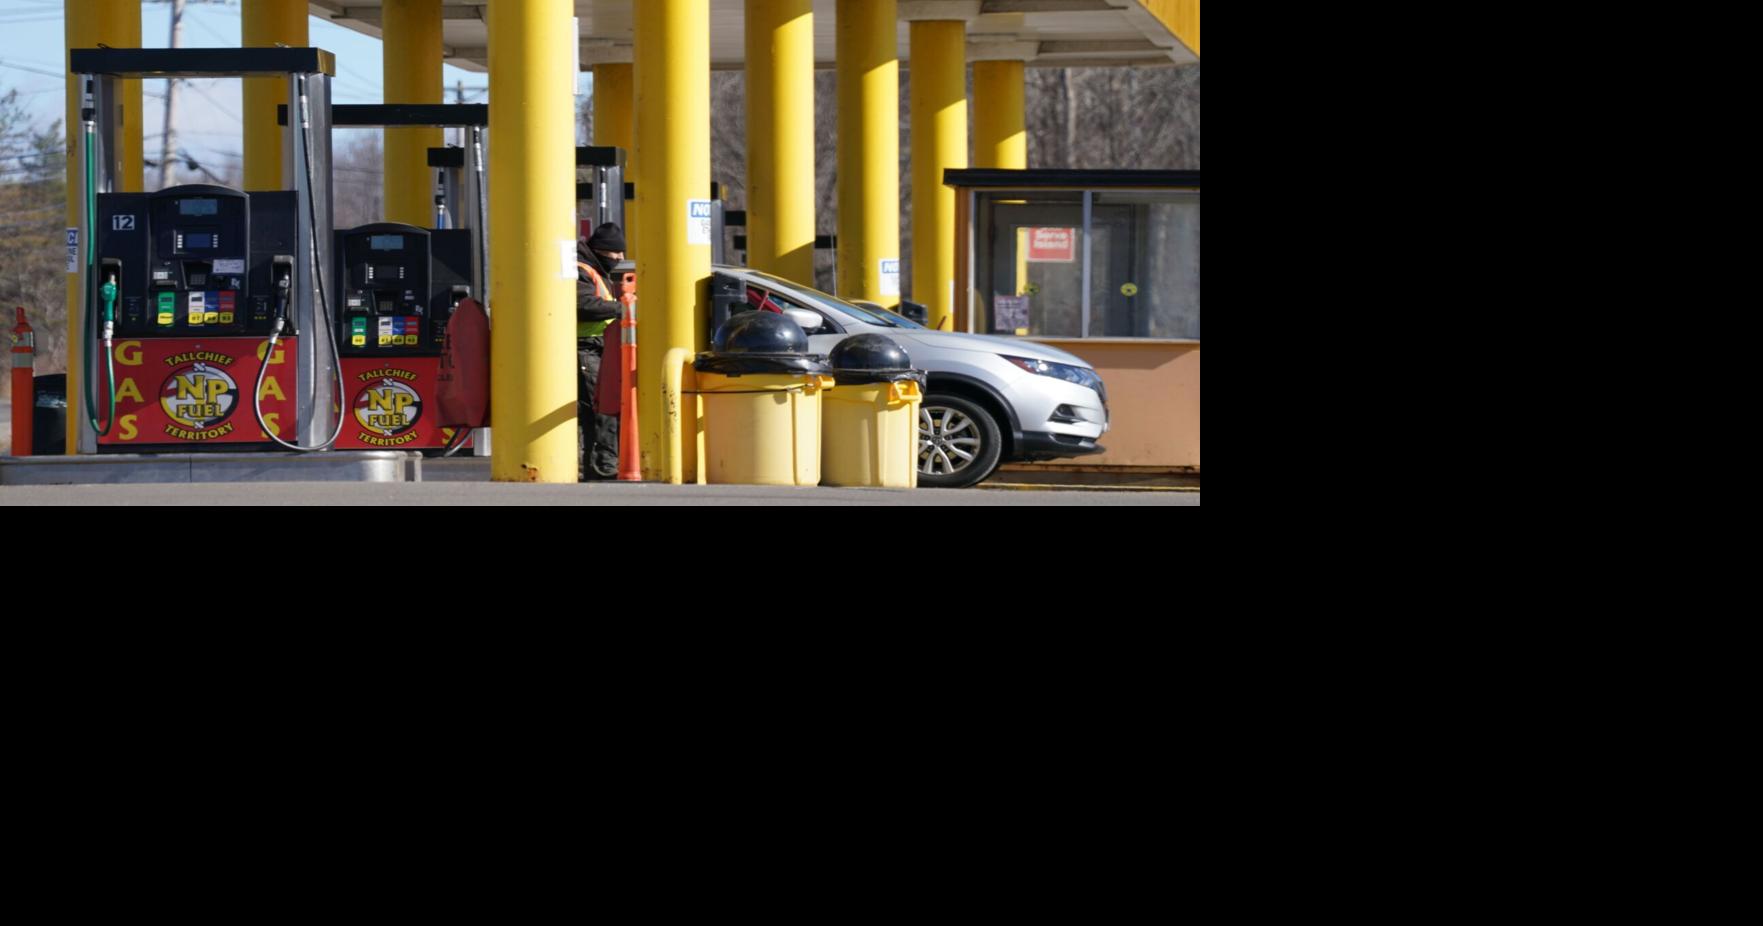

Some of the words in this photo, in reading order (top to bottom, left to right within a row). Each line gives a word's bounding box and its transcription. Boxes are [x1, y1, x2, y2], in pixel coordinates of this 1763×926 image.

[114, 216, 133, 230] 12
[164, 351, 234, 366] TALLCHIEF
[358, 368, 417, 381] TALLCHIEF
[175, 374, 229, 404] NP
[367, 388, 415, 415] NP
[176, 403, 225, 418] FUEL
[368, 414, 411, 426] FUEL
[164, 422, 234, 441] TERRITORY
[358, 430, 418, 446] TERRITORY
